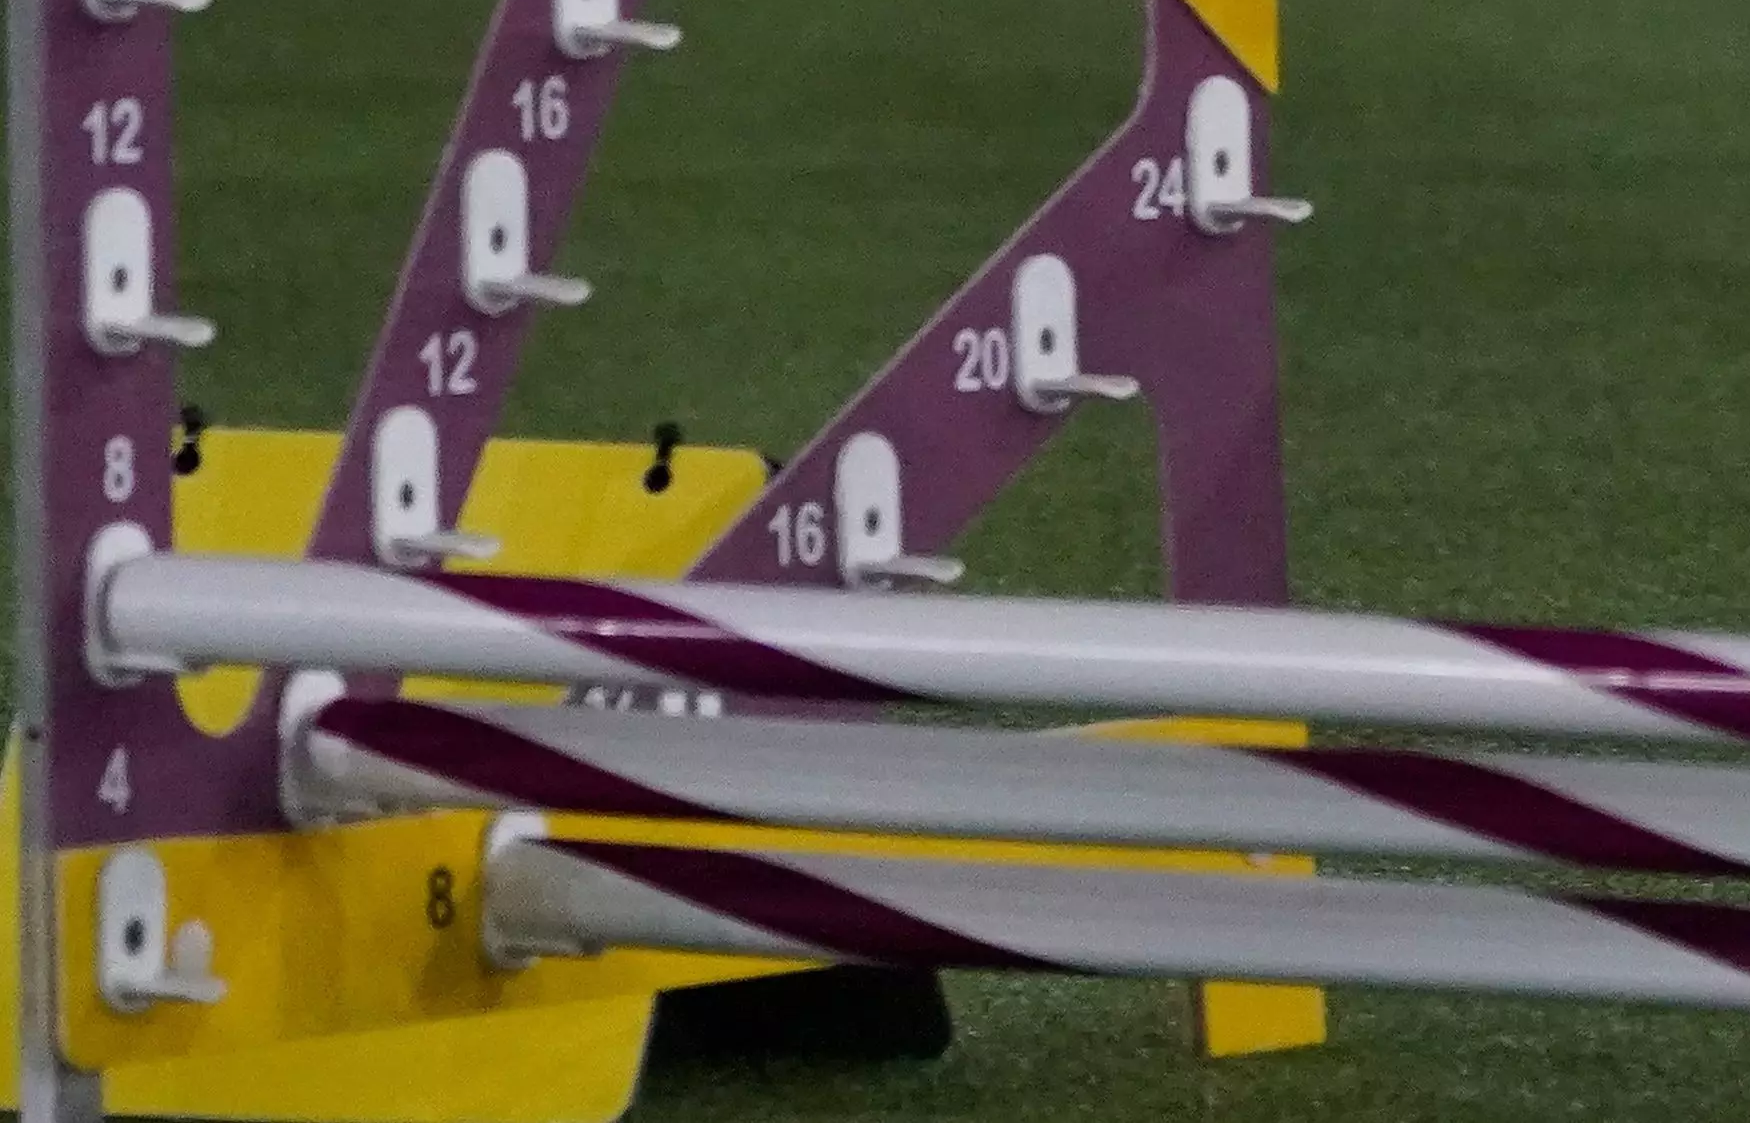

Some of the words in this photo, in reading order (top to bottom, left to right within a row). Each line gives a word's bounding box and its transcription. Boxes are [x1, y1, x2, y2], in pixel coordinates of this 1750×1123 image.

[82, 97, 143, 164] 12
[512, 75, 570, 141] 16
[1132, 157, 1188, 220] 24
[419, 330, 477, 396] 12
[953, 327, 1012, 392] 20
[103, 435, 135, 503] 8
[768, 501, 826, 566] 16
[97, 748, 131, 811] 4
[427, 867, 454, 931] 8
